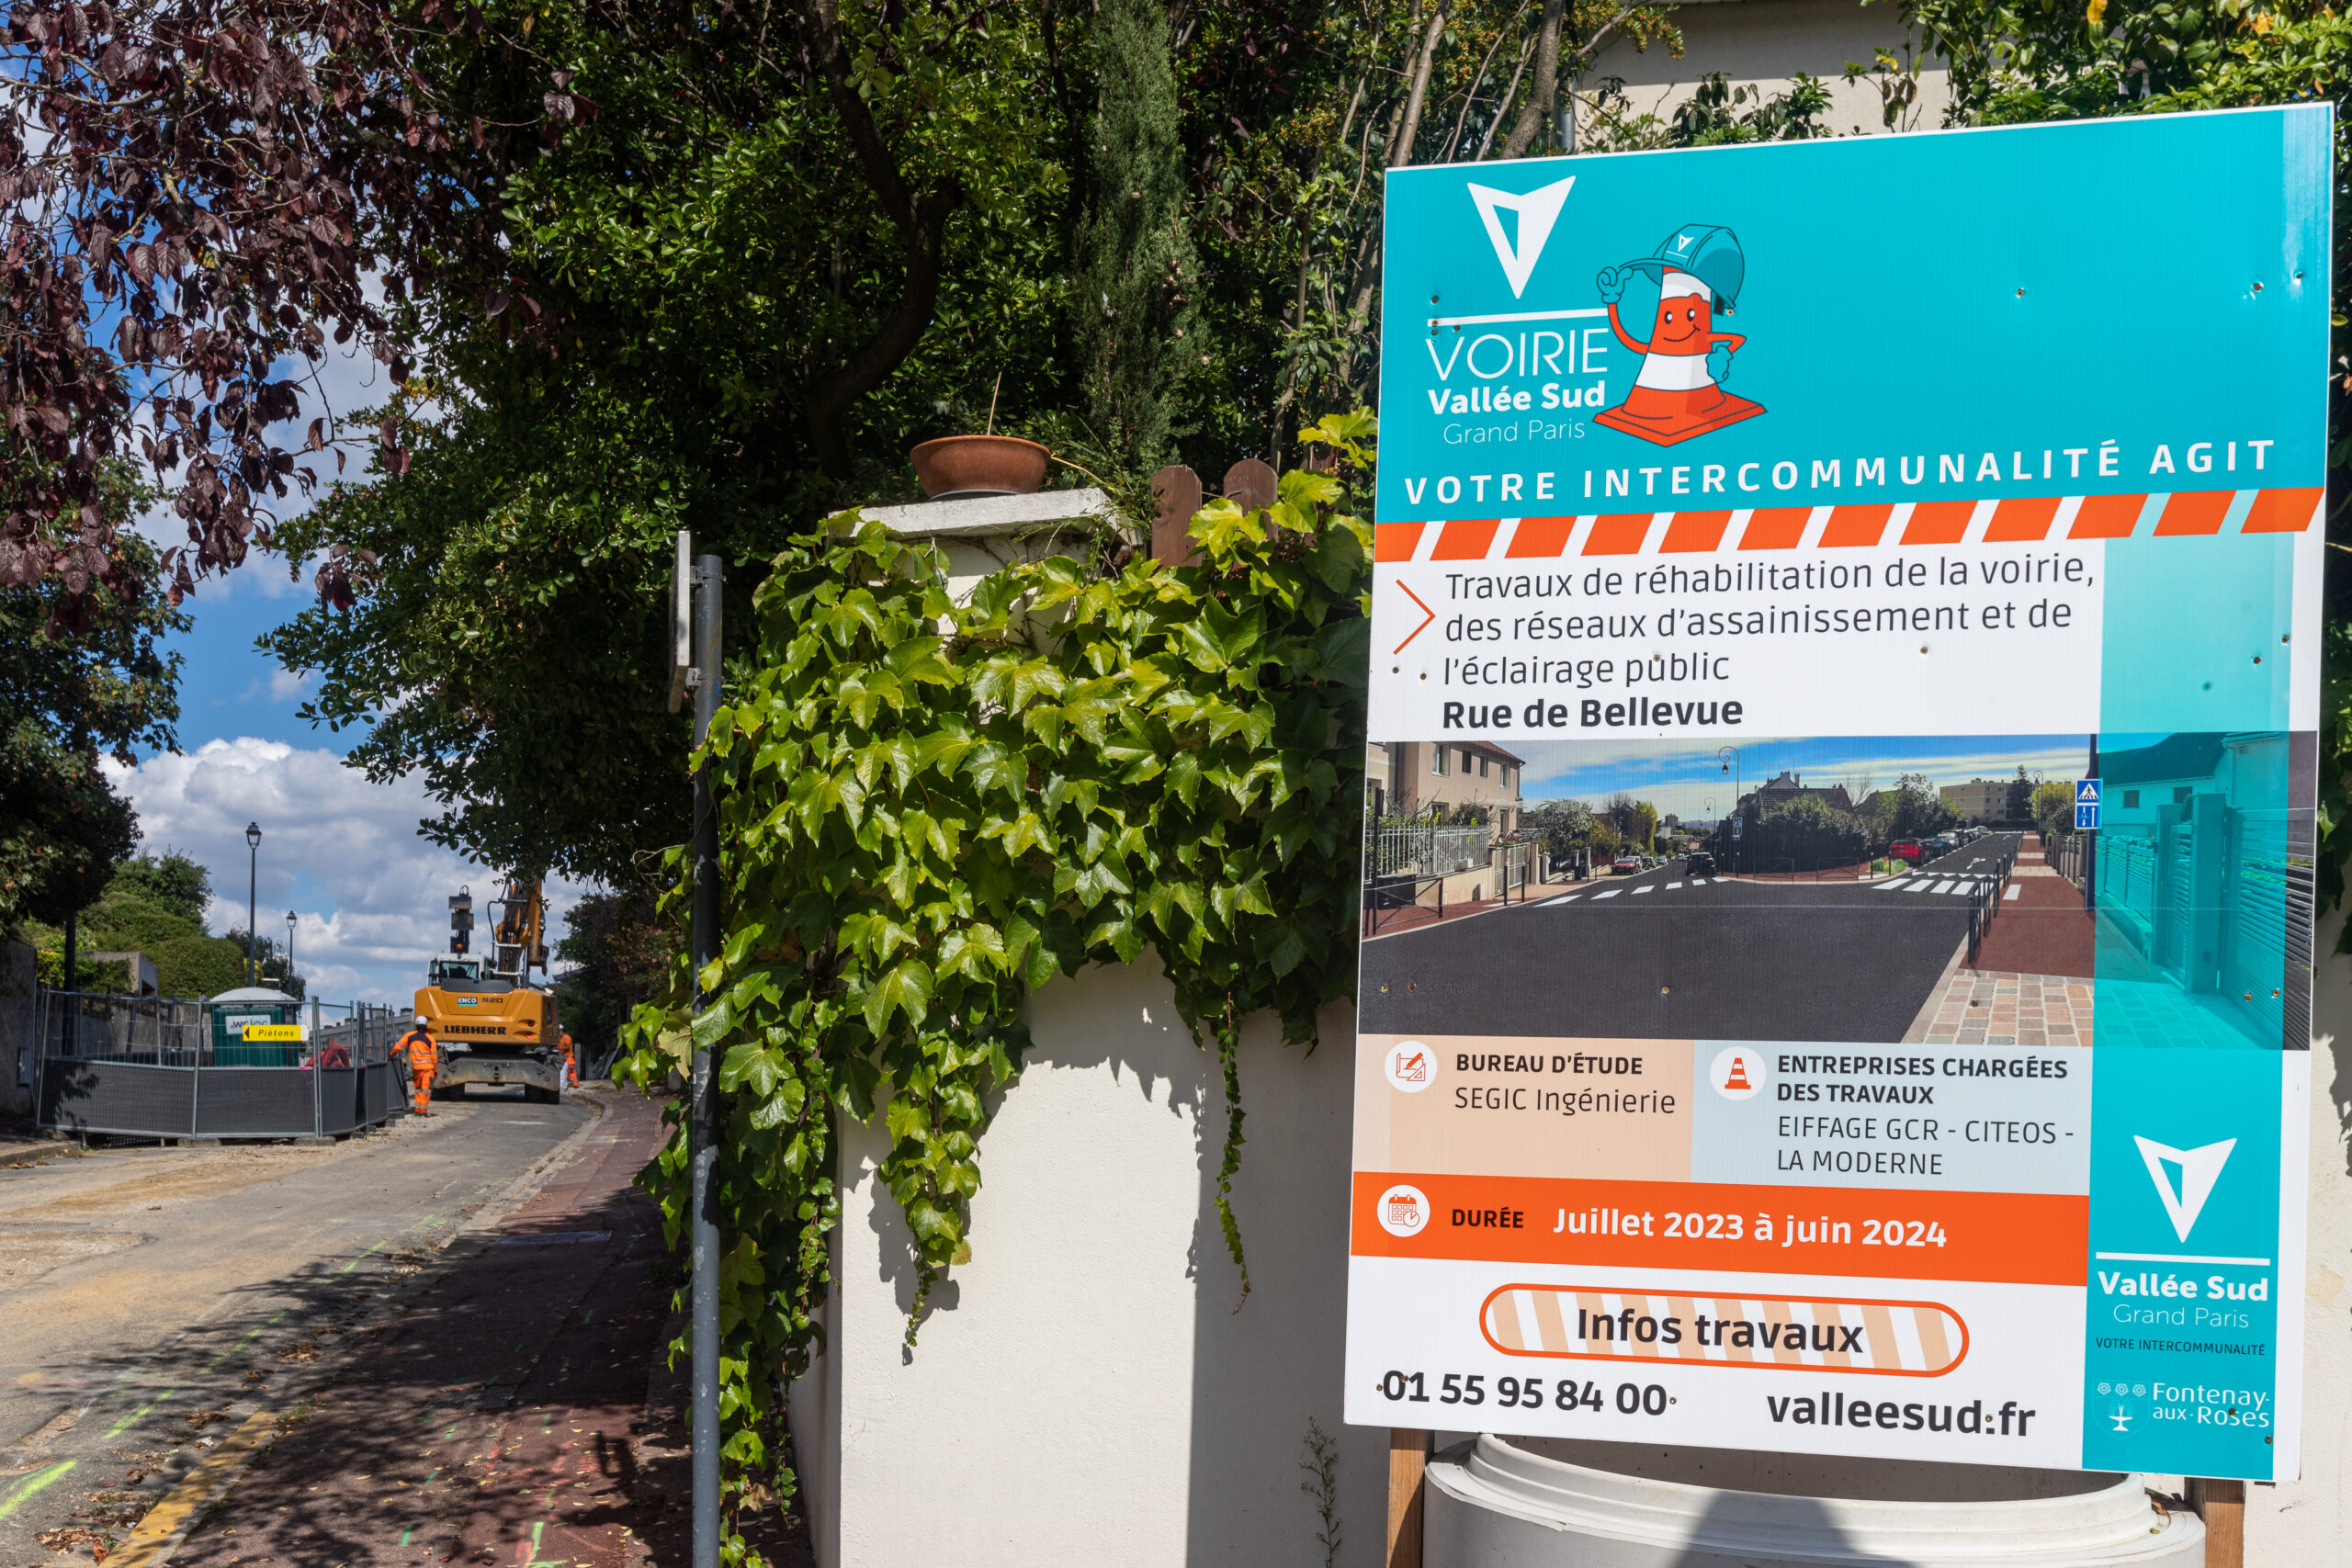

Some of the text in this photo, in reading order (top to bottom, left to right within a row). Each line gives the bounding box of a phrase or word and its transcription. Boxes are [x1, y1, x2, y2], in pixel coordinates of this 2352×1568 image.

[1426, 327, 1609, 381] VOIRIE
[1427, 379, 1605, 415] Vallée Sud
[1443, 419, 1585, 445] Grand Paris
[1404, 438, 2274, 505] VOTRE INTERCOMMUNALITÉ AGIT
[1445, 552, 2093, 600] Travaux de réhabilitation de la voirie,
[1445, 598, 2071, 642] des réseaux d’assainissement et de
[1444, 651, 1729, 689] l’éclairage public
[1442, 696, 1743, 729] Rue de Bellevue
[257, 1029, 295, 1037] Piétons
[444, 1024, 507, 1035] LIEBHERR
[1456, 1052, 1643, 1075] BUREAU D’ÉTUDE
[1778, 1055, 2068, 1079] ENTREPRISES CHARGÉES
[1454, 1087, 1675, 1116] SEGIC Ingénierie
[1777, 1083, 1934, 1104] DES TRAVAUX
[1779, 1115, 1877, 1139] EIFFAGE
[1886, 1118, 1939, 1141] GCR
[1965, 1120, 2056, 1145] CITEOS
[1778, 1149, 1942, 1175] LA MODERNE
[1452, 1206, 1524, 1229] DURÉE
[1553, 1207, 1947, 1247] Juillet 2023 à juin 2024
[2098, 1270, 2268, 1302] Vallée Sud
[1578, 1308, 1864, 1353] Infos travaux
[2113, 1303, 2249, 1328] Grand Paris
[2096, 1337, 2265, 1356] VOTRE INTERCOMMUNALITÉ
[1382, 1370, 1668, 1416] 01 55 95 84 00
[1767, 1391, 2036, 1437] valleesud.fr
